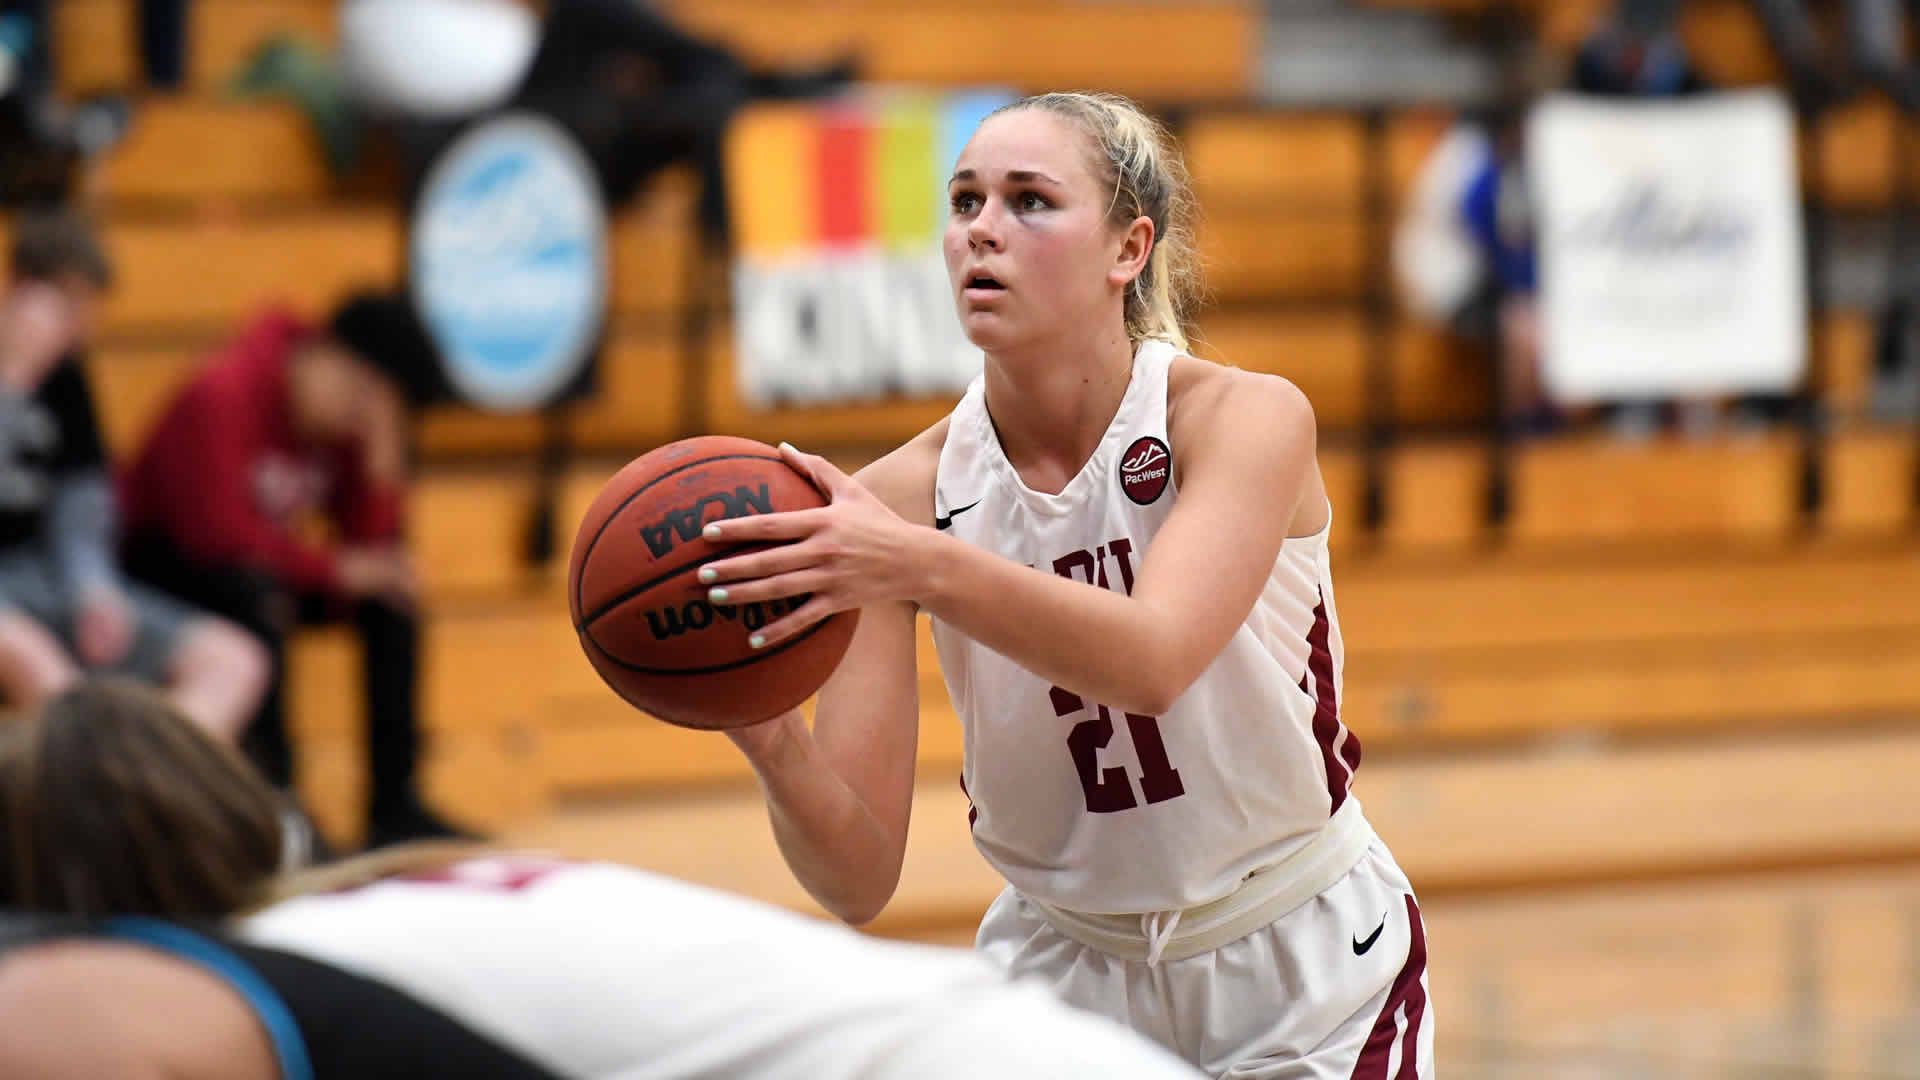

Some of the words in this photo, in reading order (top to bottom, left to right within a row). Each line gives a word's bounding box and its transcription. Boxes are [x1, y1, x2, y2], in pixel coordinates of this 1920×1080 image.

[1124, 467, 1167, 486] PacWest
[640, 484, 775, 560] NCAA
[1049, 685, 1186, 814] 21
